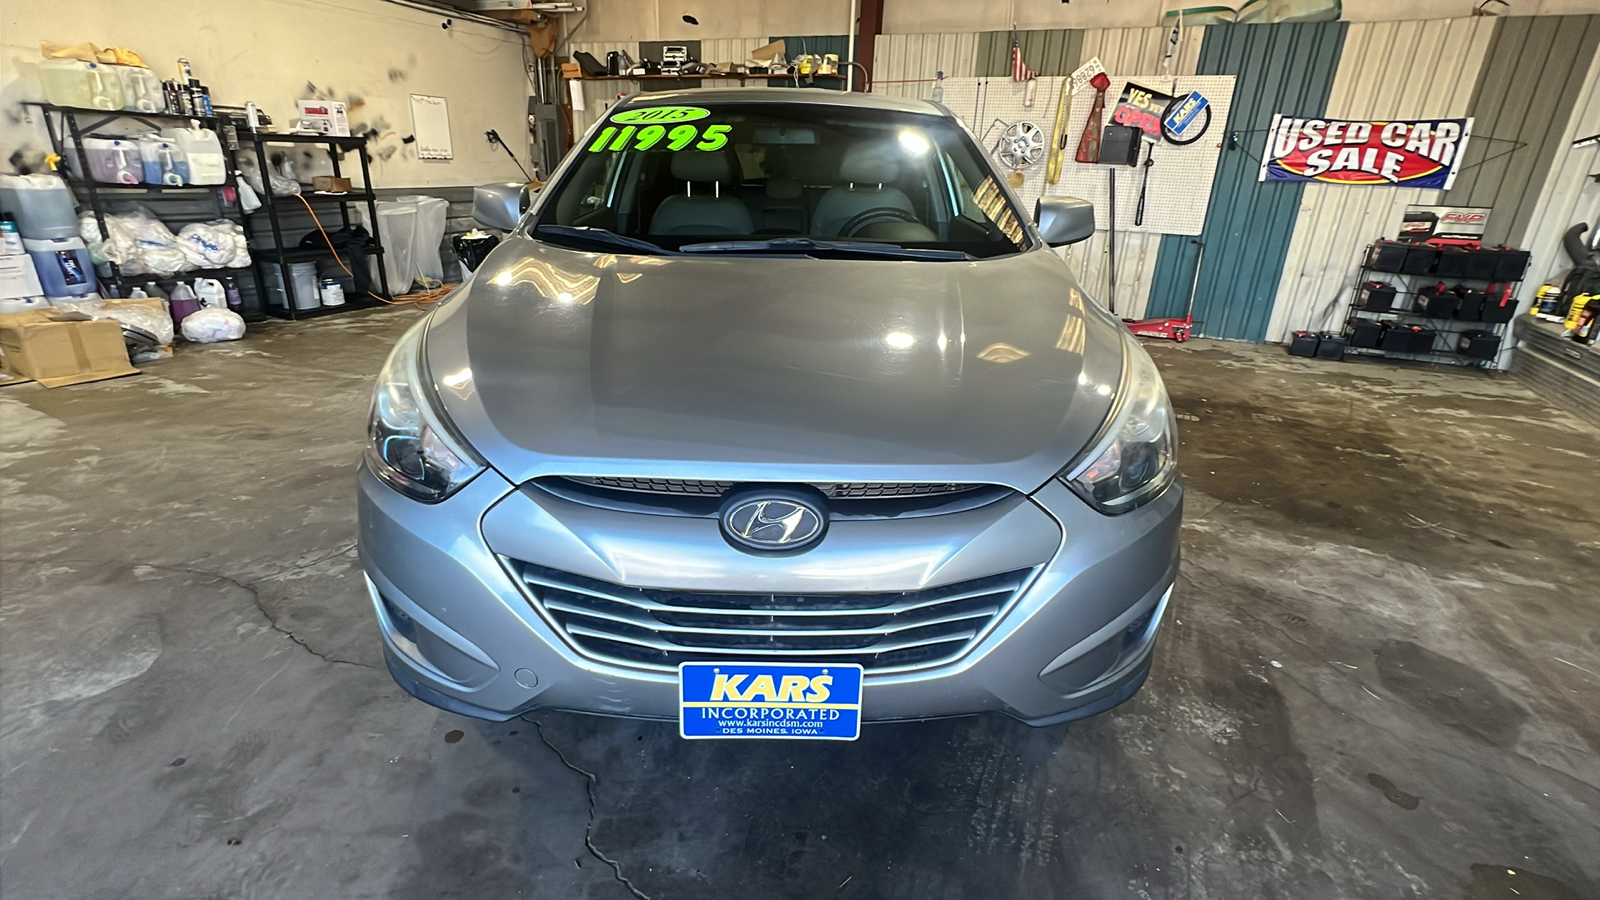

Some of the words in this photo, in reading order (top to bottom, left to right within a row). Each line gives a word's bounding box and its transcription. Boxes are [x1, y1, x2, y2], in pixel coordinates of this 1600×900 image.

[1127, 88, 1153, 109] YES
[624, 108, 696, 121] 2015
[1173, 97, 1198, 125] KARS
[588, 125, 733, 152] 11995
[1274, 118, 1373, 158] USED
[1380, 122, 1460, 167] CAR
[1302, 147, 1404, 183] SALE
[1440, 212, 1487, 223] FVP
[709, 673, 834, 703] KARS
[701, 707, 840, 721] INCORPORATED
[718, 718, 823, 728] www.karsincdsm.com
